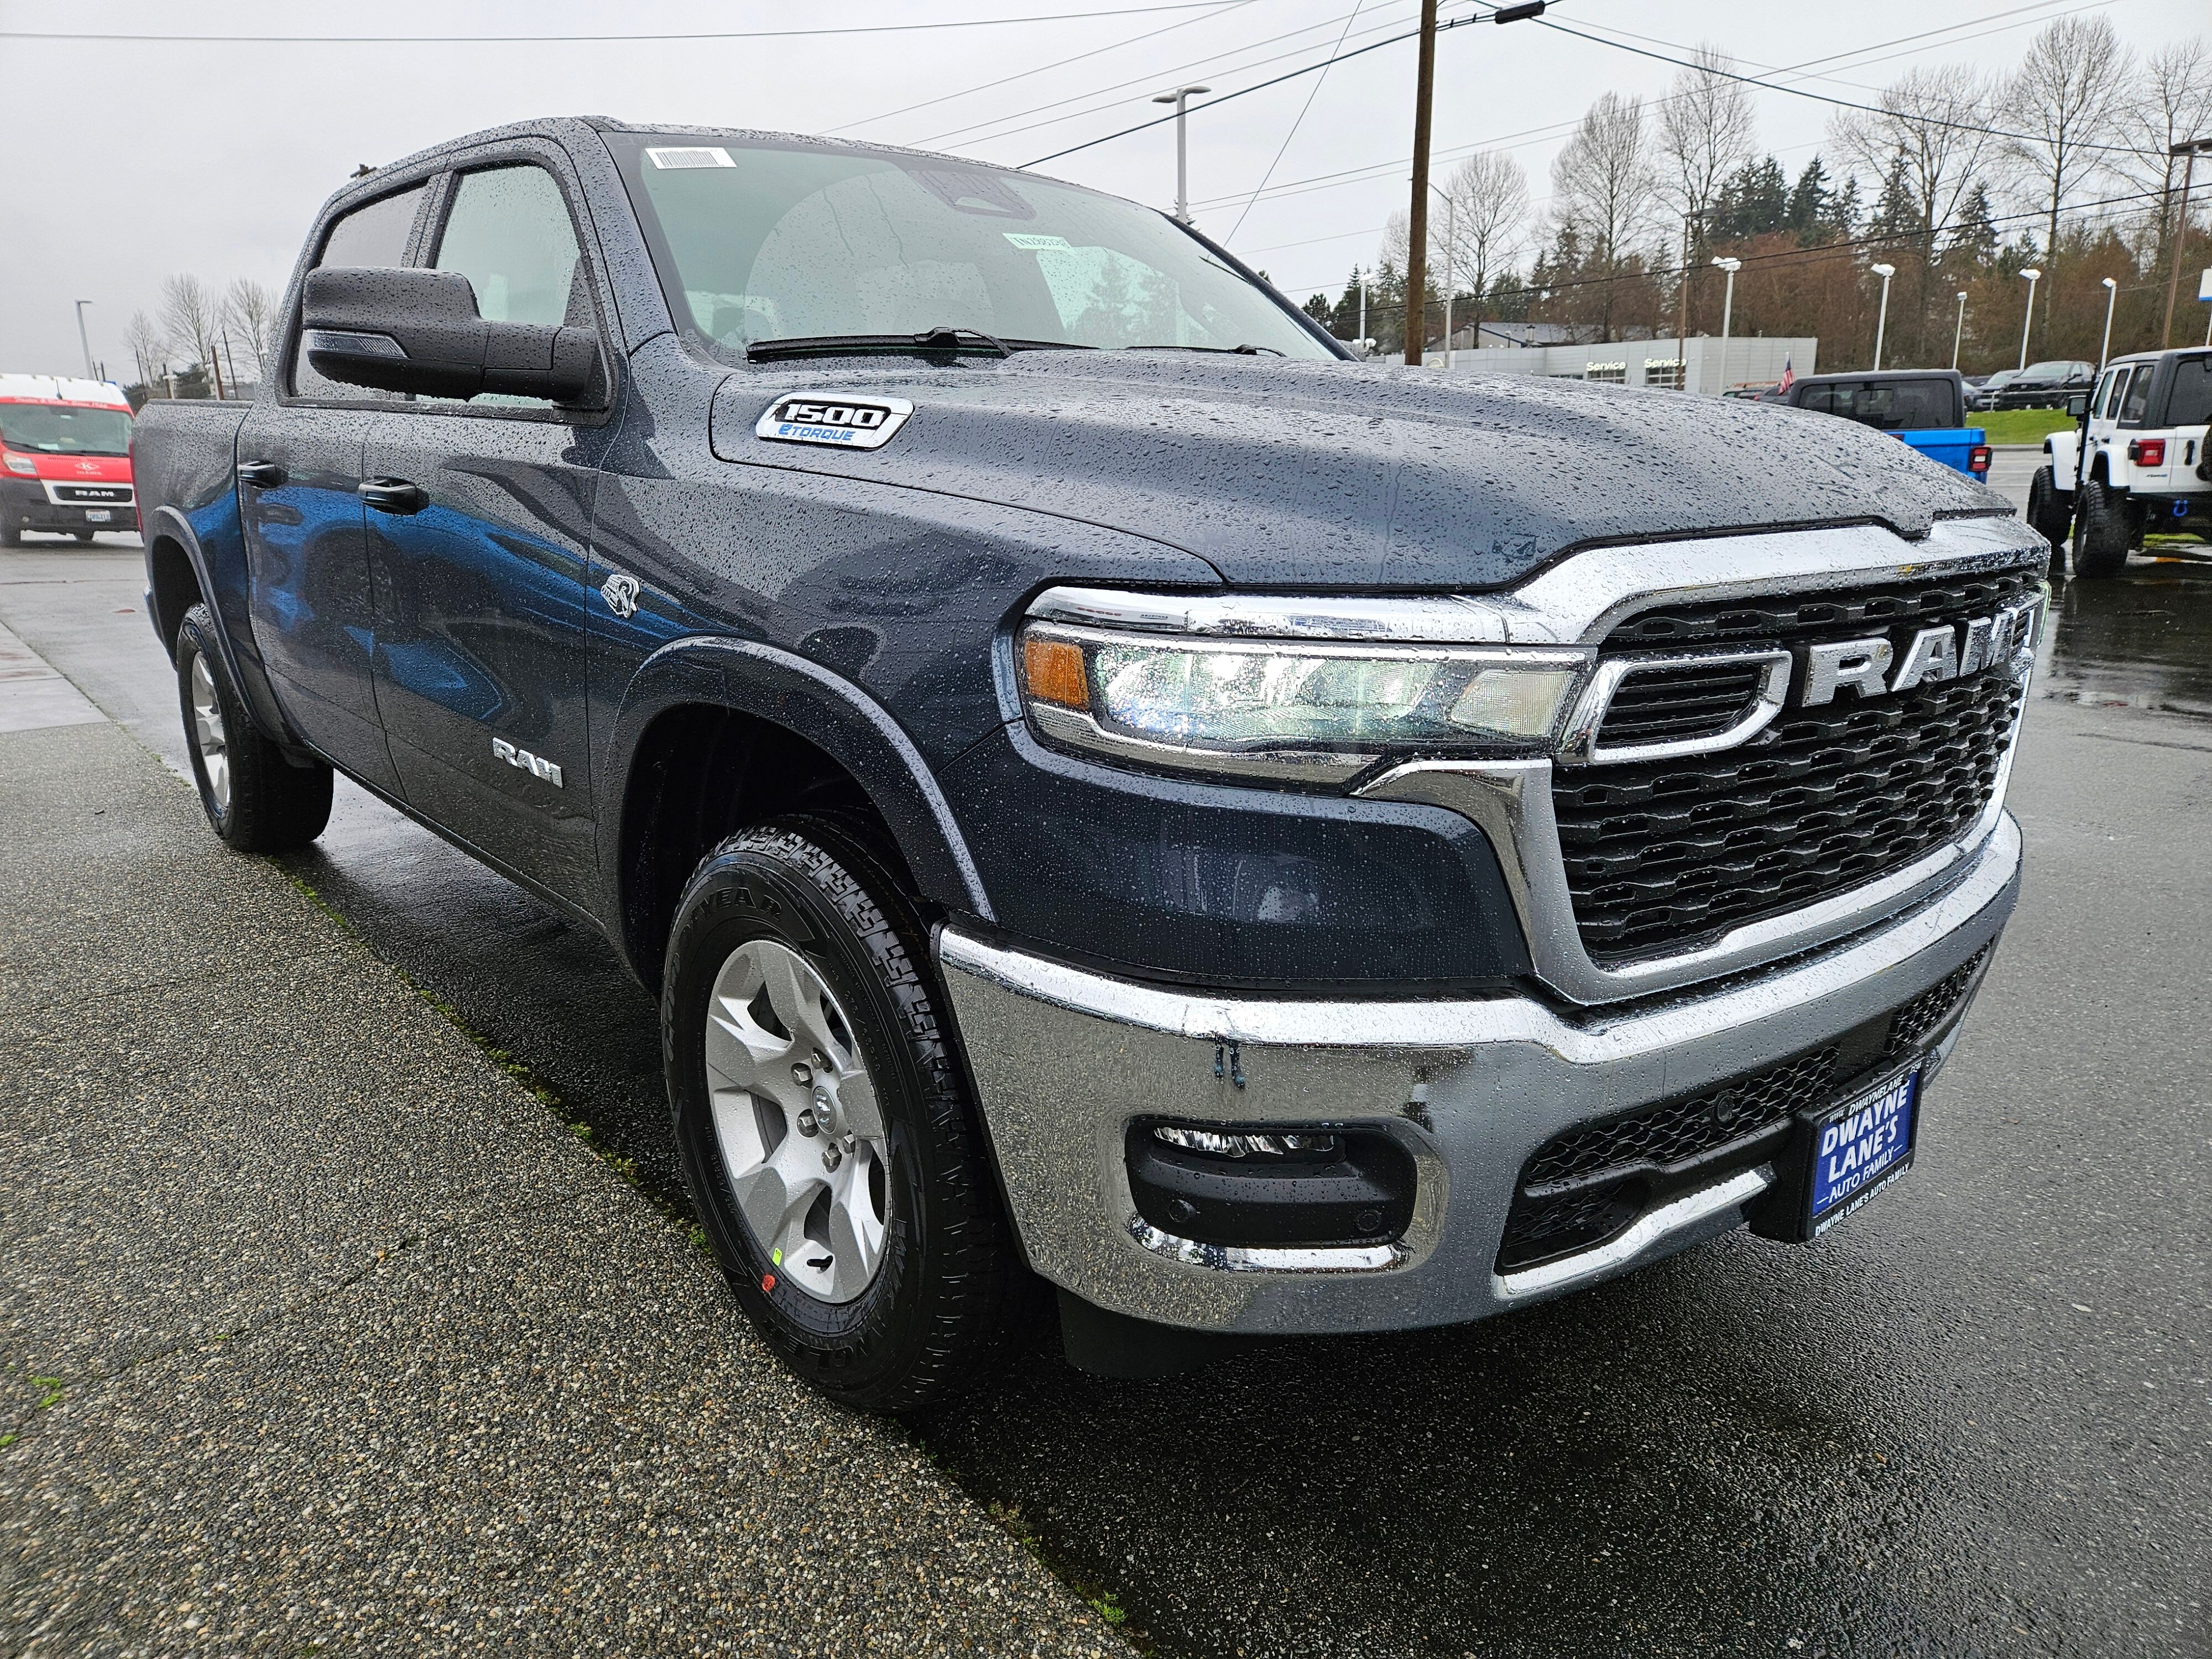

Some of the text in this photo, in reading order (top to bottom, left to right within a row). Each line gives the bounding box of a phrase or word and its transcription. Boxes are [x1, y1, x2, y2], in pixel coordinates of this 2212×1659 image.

[1586, 361, 1626, 372] Service
[784, 403, 886, 427] 1500
[1802, 611, 2014, 707] RAM
[493, 737, 563, 789] RAM
[1821, 1079, 1911, 1157] DWAYNE
[1828, 1115, 1898, 1183] LANE'S
[1815, 1162, 1910, 1237] DWAYNE LANE'S AUTO FAMILY
[1829, 1146, 1895, 1203] AUTO FAMILY
